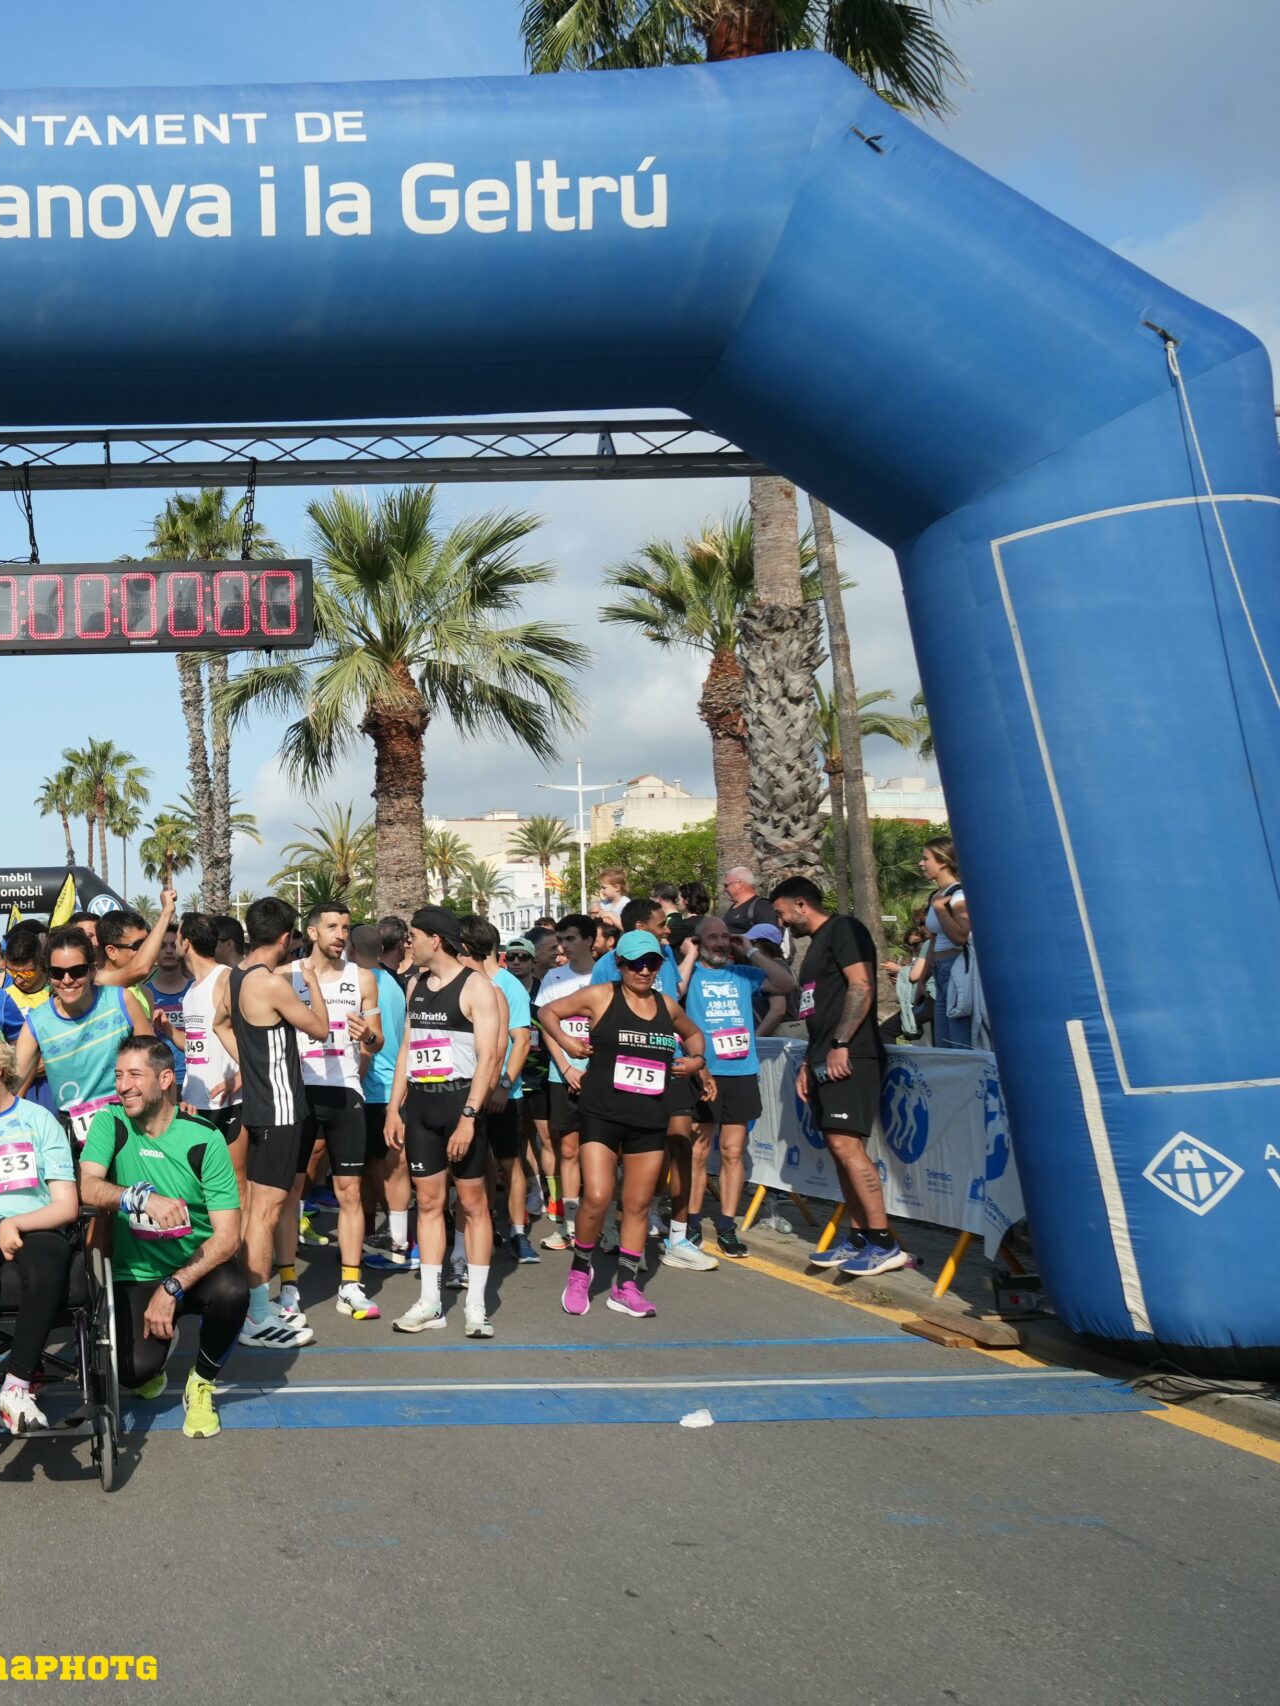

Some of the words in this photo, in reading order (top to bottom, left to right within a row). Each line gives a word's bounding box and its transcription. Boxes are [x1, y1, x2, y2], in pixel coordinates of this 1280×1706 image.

[295, 110, 369, 144] DE
[259, 164, 278, 238] i
[304, 160, 374, 238] la
[400, 154, 669, 236] Geltrú
[619, 1032, 647, 1045] INTER
[718, 1036, 749, 1049] 1154
[416, 1049, 442, 1064] 912
[624, 1066, 655, 1083] 715
